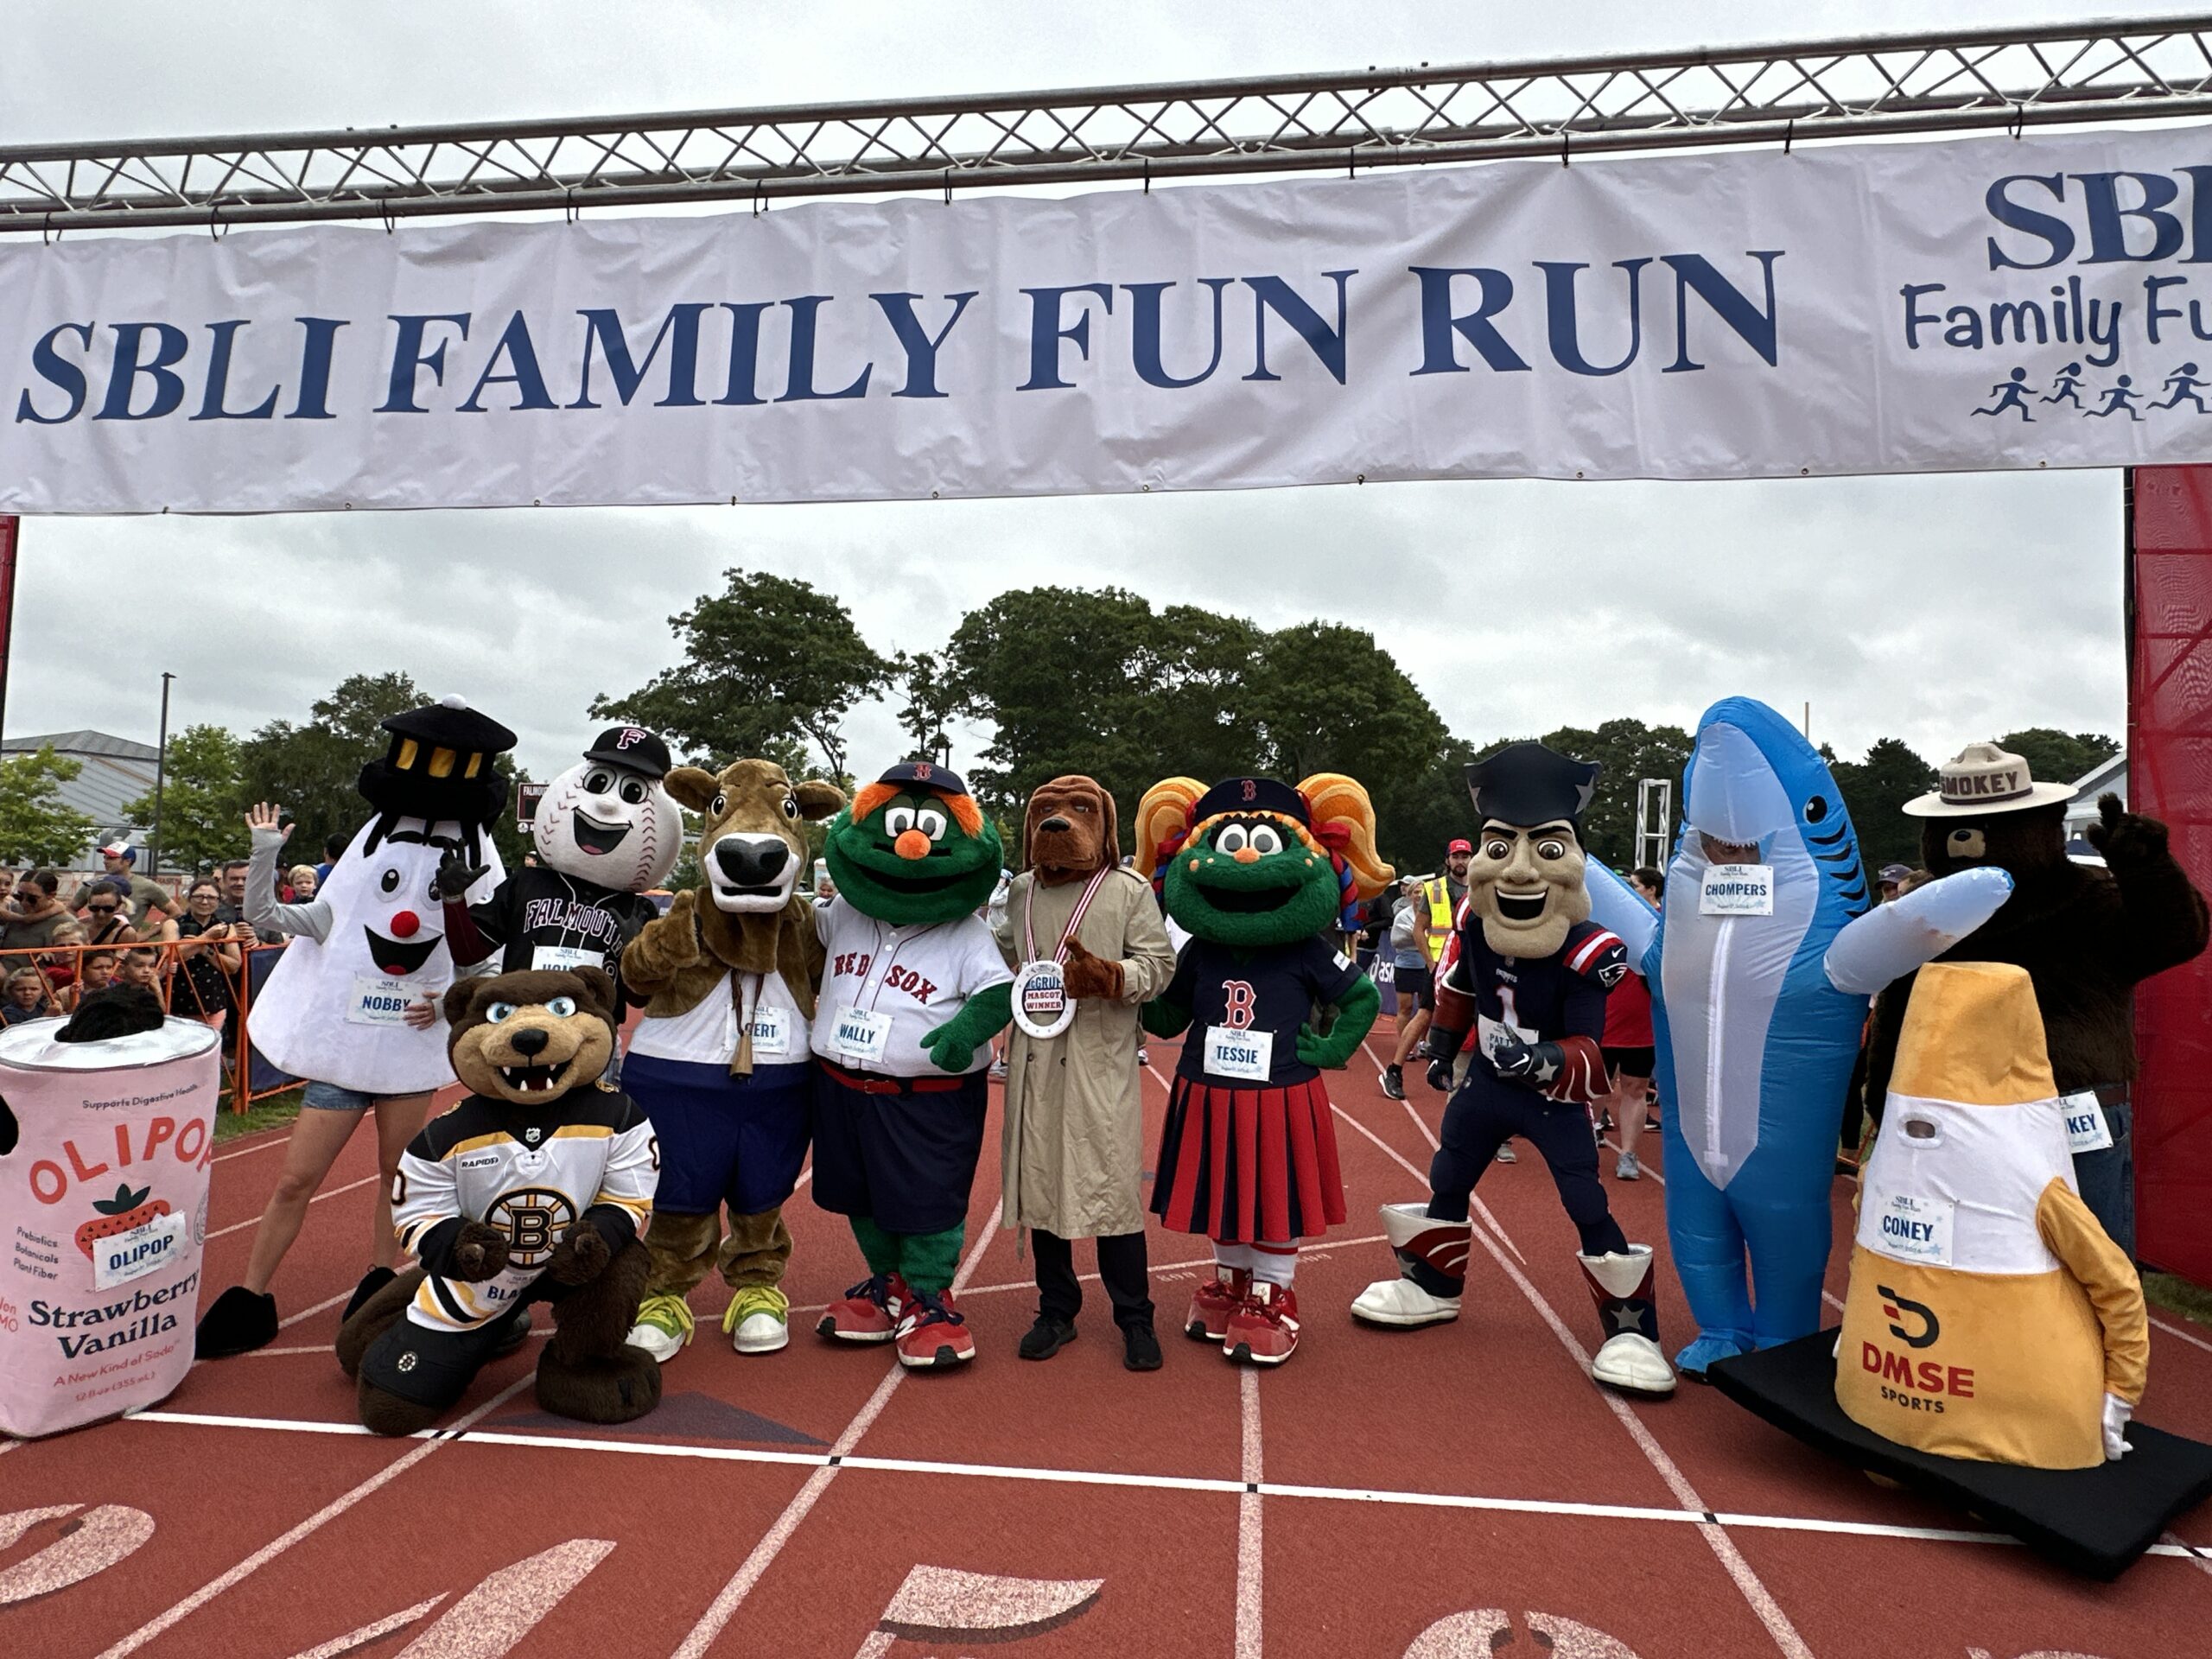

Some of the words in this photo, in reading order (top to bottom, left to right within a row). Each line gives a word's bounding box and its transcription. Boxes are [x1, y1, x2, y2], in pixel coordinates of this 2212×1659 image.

[1899, 275, 2122, 367] Family
[16, 316, 351, 424] SBLI
[372, 290, 979, 414] FAMILY
[1016, 269, 1359, 391] FUN
[1408, 250, 1786, 378] RUN
[616, 728, 647, 750] F
[1241, 779, 1257, 802] B
[1705, 883, 1767, 896] CHOMPERS
[834, 951, 870, 977] RED
[885, 964, 938, 1005] SOX
[362, 995, 411, 1012] NOBBY
[1027, 991, 1060, 1000] MASCOT
[1219, 980, 1257, 1030] B
[839, 1023, 875, 1045] WALLY
[1217, 1046, 1258, 1065] TESSIE
[82, 1098, 130, 1111] Supports
[132, 1092, 174, 1106] Digestive
[175, 1084, 198, 1097] Health
[16, 1226, 58, 1248] Prebiotics
[510, 1206, 553, 1253] B
[1883, 1215, 1934, 1242] CONEY
[15, 1242, 59, 1264] Botanicals
[110, 1234, 174, 1270] OLIPOP
[13, 1257, 32, 1274] Plant
[33, 1265, 58, 1281] Fiber
[29, 1268, 200, 1328] Strawberry
[57, 1313, 178, 1360] Vanilla
[54, 1376, 66, 1388] A
[68, 1370, 98, 1382] New
[99, 1357, 128, 1375] Kind
[130, 1354, 143, 1366] of
[1863, 1341, 1974, 1398] DMSE
[1881, 1386, 1944, 1414] SPORTS
